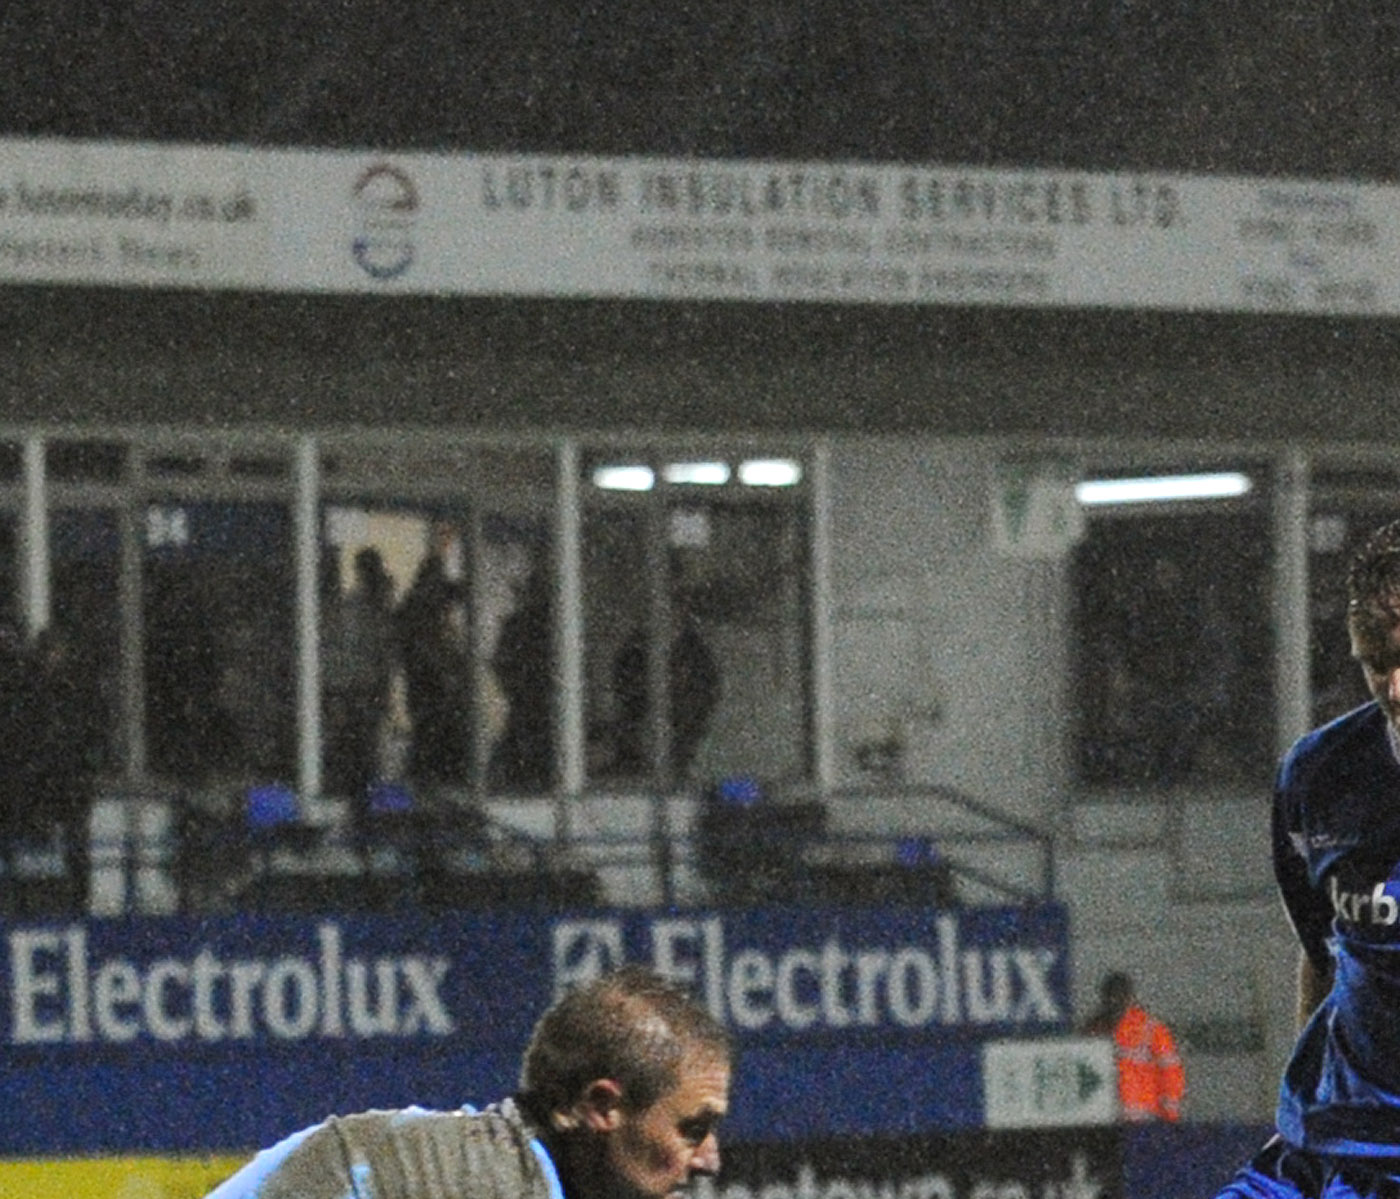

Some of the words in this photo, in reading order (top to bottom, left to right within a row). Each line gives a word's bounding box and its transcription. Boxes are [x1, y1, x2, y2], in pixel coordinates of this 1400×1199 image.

[481, 165, 620, 213] LUTON
[640, 168, 880, 220] INSULATION
[899, 174, 1090, 226] SERVICES
[9, 922, 457, 1045] Electrolux
